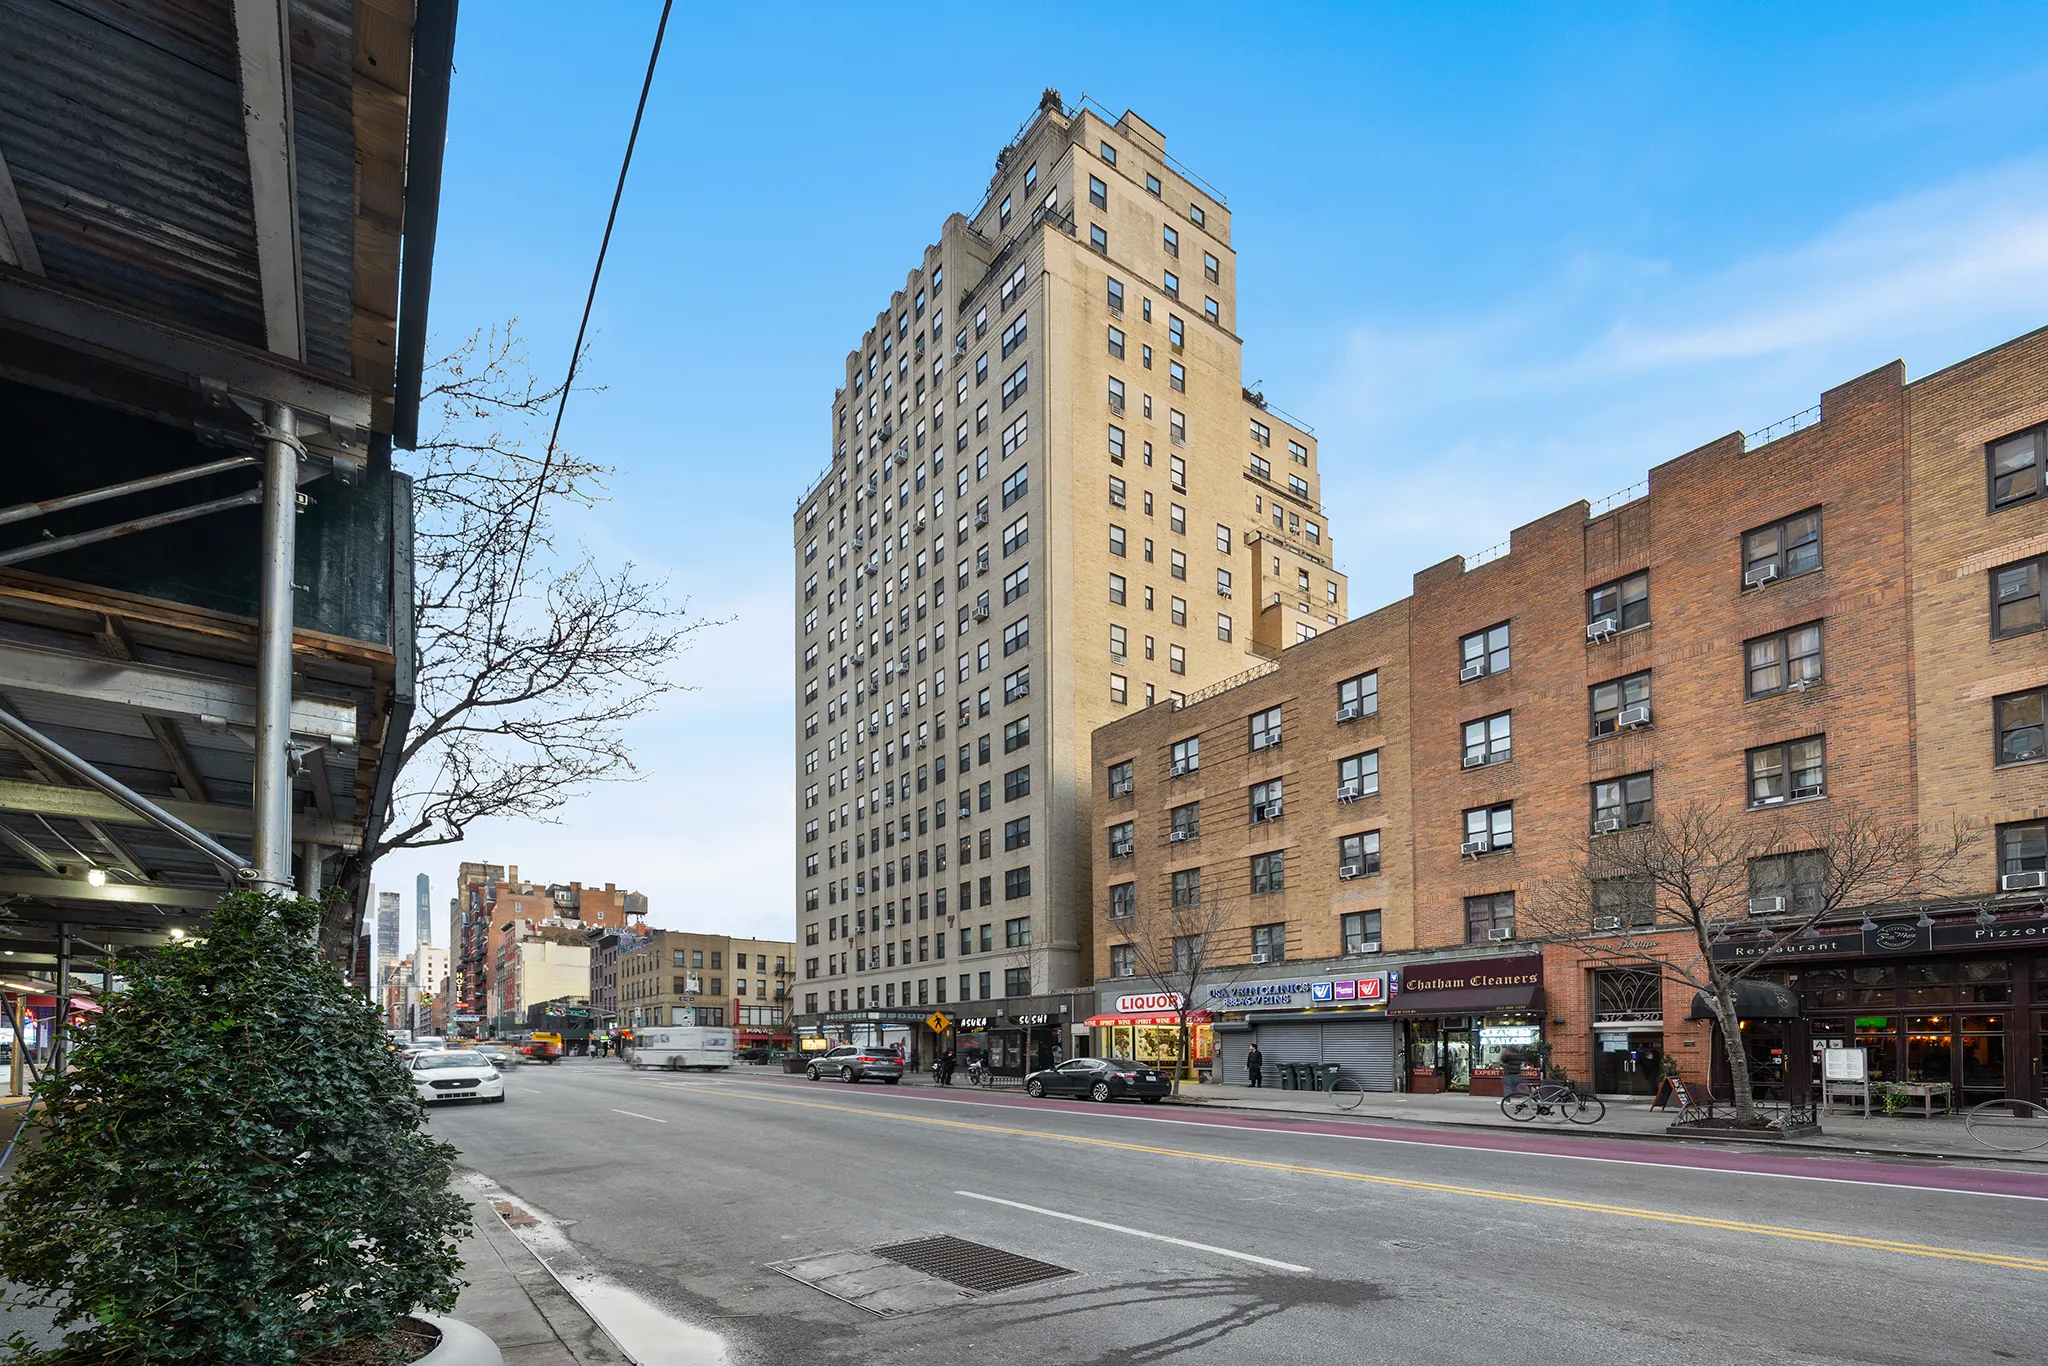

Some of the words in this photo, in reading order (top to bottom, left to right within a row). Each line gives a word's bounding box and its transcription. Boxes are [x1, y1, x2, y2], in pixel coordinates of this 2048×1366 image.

[1406, 978, 1465, 991] Chatham
[1469, 973, 1538, 987] Cleaners
[1209, 988, 1227, 999] USA
[1230, 985, 1258, 997] VEIN
[1259, 982, 1310, 996] CLINICS
[1121, 995, 1179, 1010] LIQUOR
[960, 1017, 987, 1027] ASUKA
[1019, 1014, 1048, 1025] SUSHI
[1601, 1014, 1624, 1022] 312
[1634, 1012, 1660, 1022] 320
